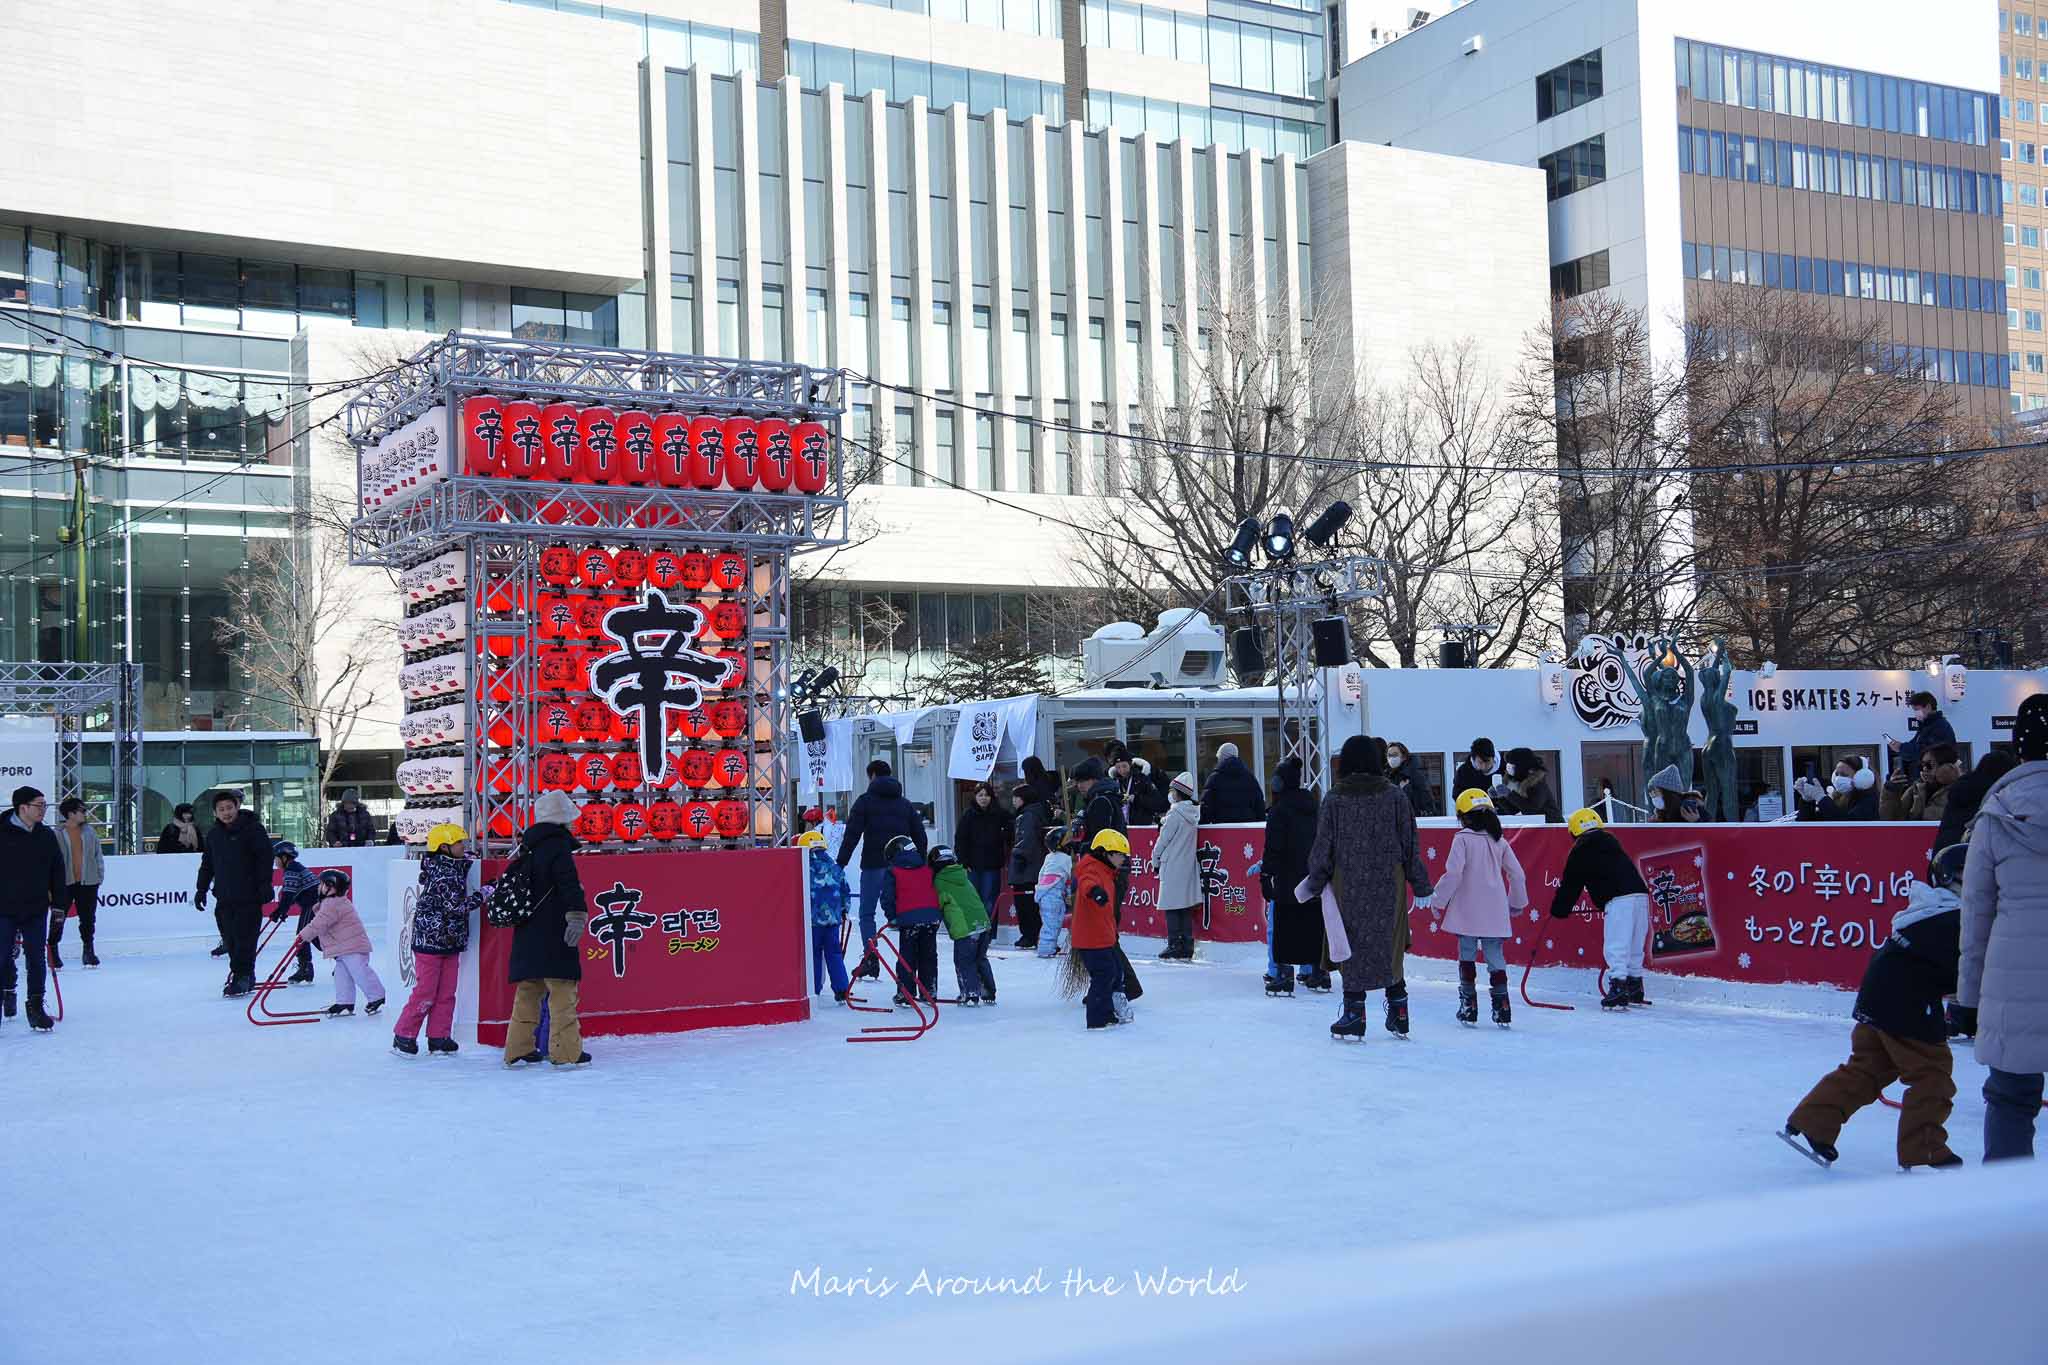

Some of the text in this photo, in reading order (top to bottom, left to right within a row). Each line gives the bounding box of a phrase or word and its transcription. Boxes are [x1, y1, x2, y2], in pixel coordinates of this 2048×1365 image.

[475, 408, 504, 460] 辛
[512, 415, 542, 466] 辛
[551, 415, 581, 466] 辛
[587, 419, 617, 470] 辛
[625, 423, 654, 472] 辛
[663, 424, 691, 475] 辛
[698, 427, 725, 476] 辛
[735, 428, 759, 477] 辛
[766, 430, 792, 479] 辛
[801, 432, 827, 480] 辛
[586, 554, 607, 581] 辛
[655, 557, 675, 584] 辛
[720, 559, 741, 585] 辛
[551, 604, 572, 632] 辛
[591, 588, 733, 784] 辛
[1748, 689, 1777, 711] ICE
[1782, 688, 1850, 711] SKATES
[549, 708, 569, 736] 辛
[586, 759, 607, 786] 辛
[723, 755, 742, 782] 辛
[623, 810, 643, 836] 辛
[690, 808, 711, 833] 辛
[97, 891, 187, 907] NONGSHIM
[1650, 870, 1682, 924] 辛
[589, 881, 657, 977] 辛
[661, 908, 721, 937] 라면
[587, 948, 609, 960] シン
[669, 937, 720, 955] ラーメン
